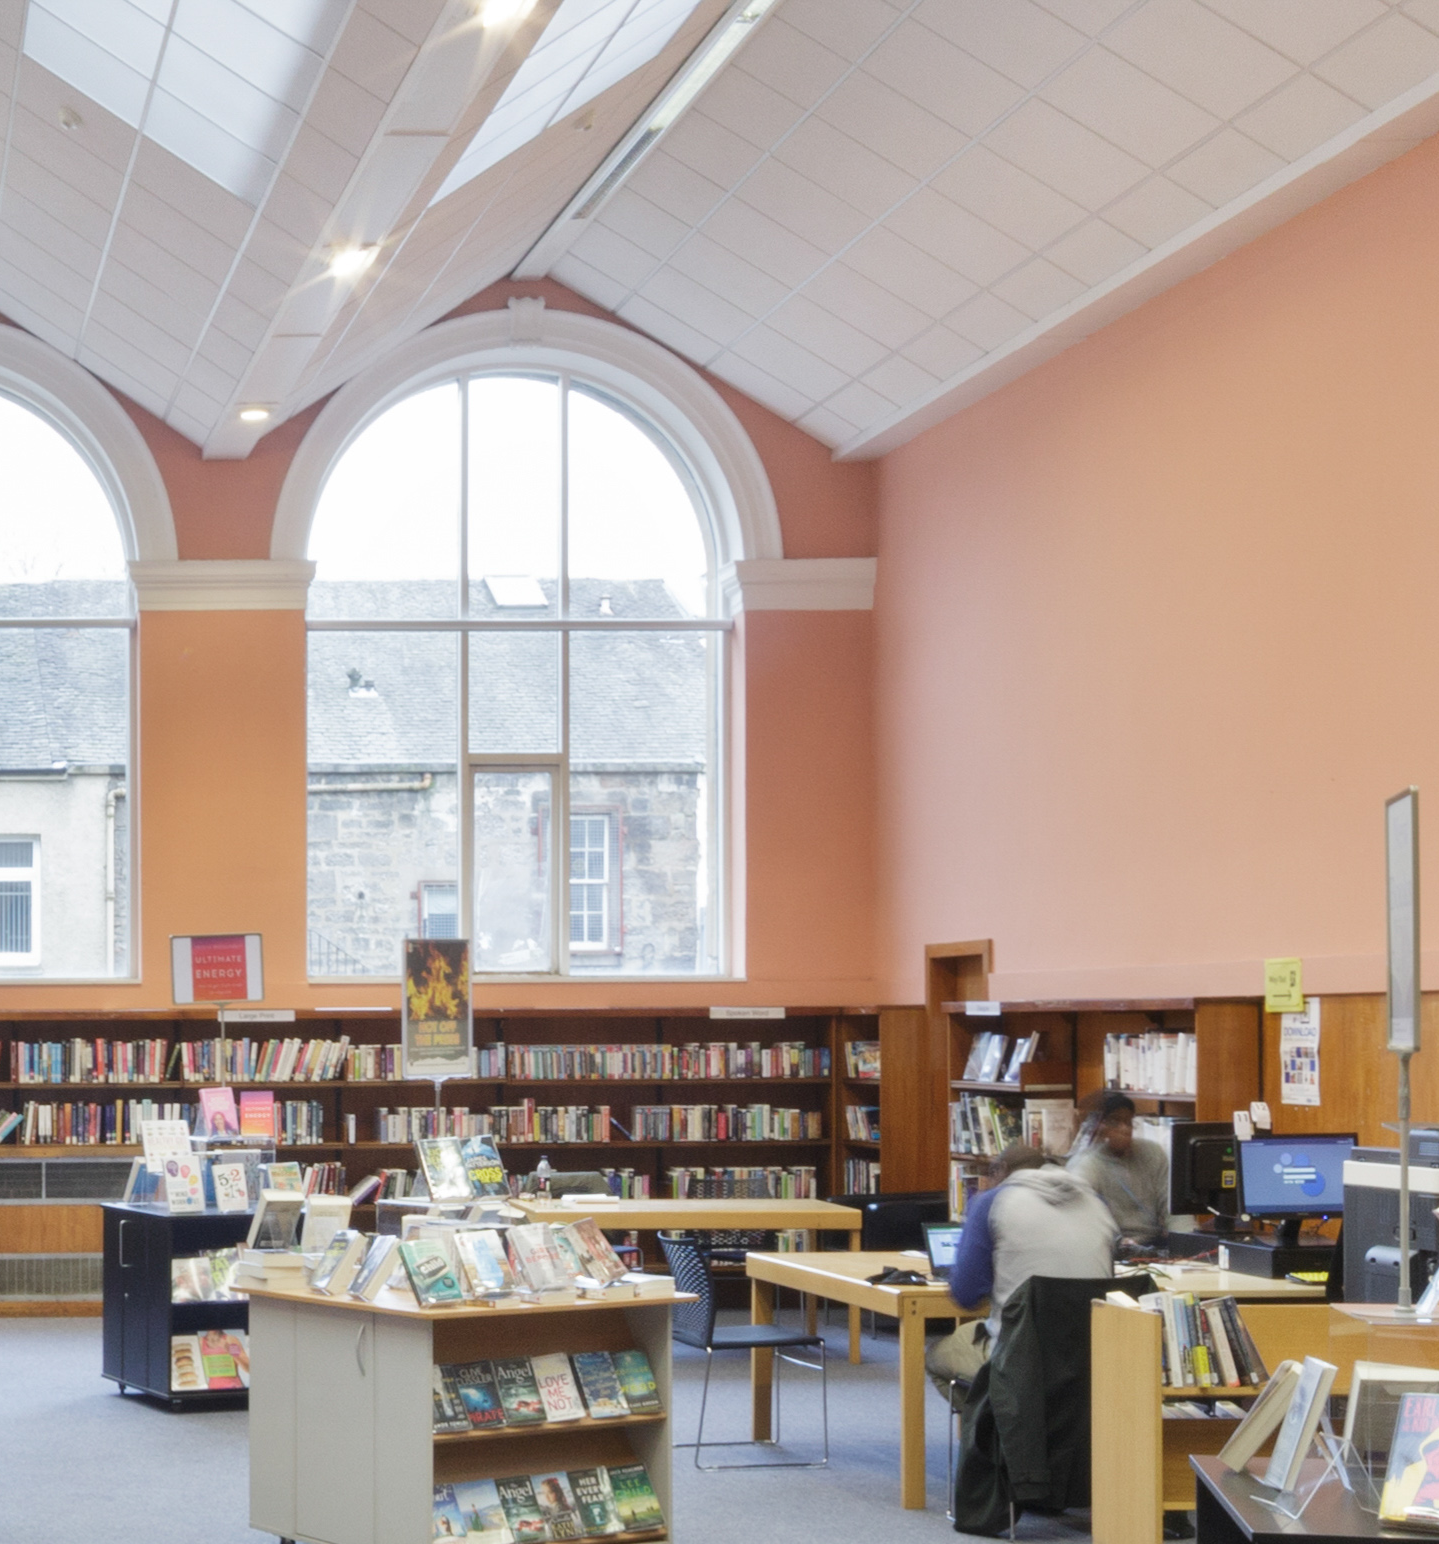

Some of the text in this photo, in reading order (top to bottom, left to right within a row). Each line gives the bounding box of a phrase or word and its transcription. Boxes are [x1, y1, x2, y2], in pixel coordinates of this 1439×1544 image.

[194, 954, 243, 966] ULTIMATE
[194, 968, 243, 980] ENERGY
[1282, 1026, 1317, 1039] DOWNLOAD
[1236, 1113, 1249, 1124] 11
[497, 1362, 534, 1386] Angel
[538, 1373, 570, 1390] LOVE
[547, 1397, 576, 1411] NOT
[499, 1480, 534, 1504] Angel
